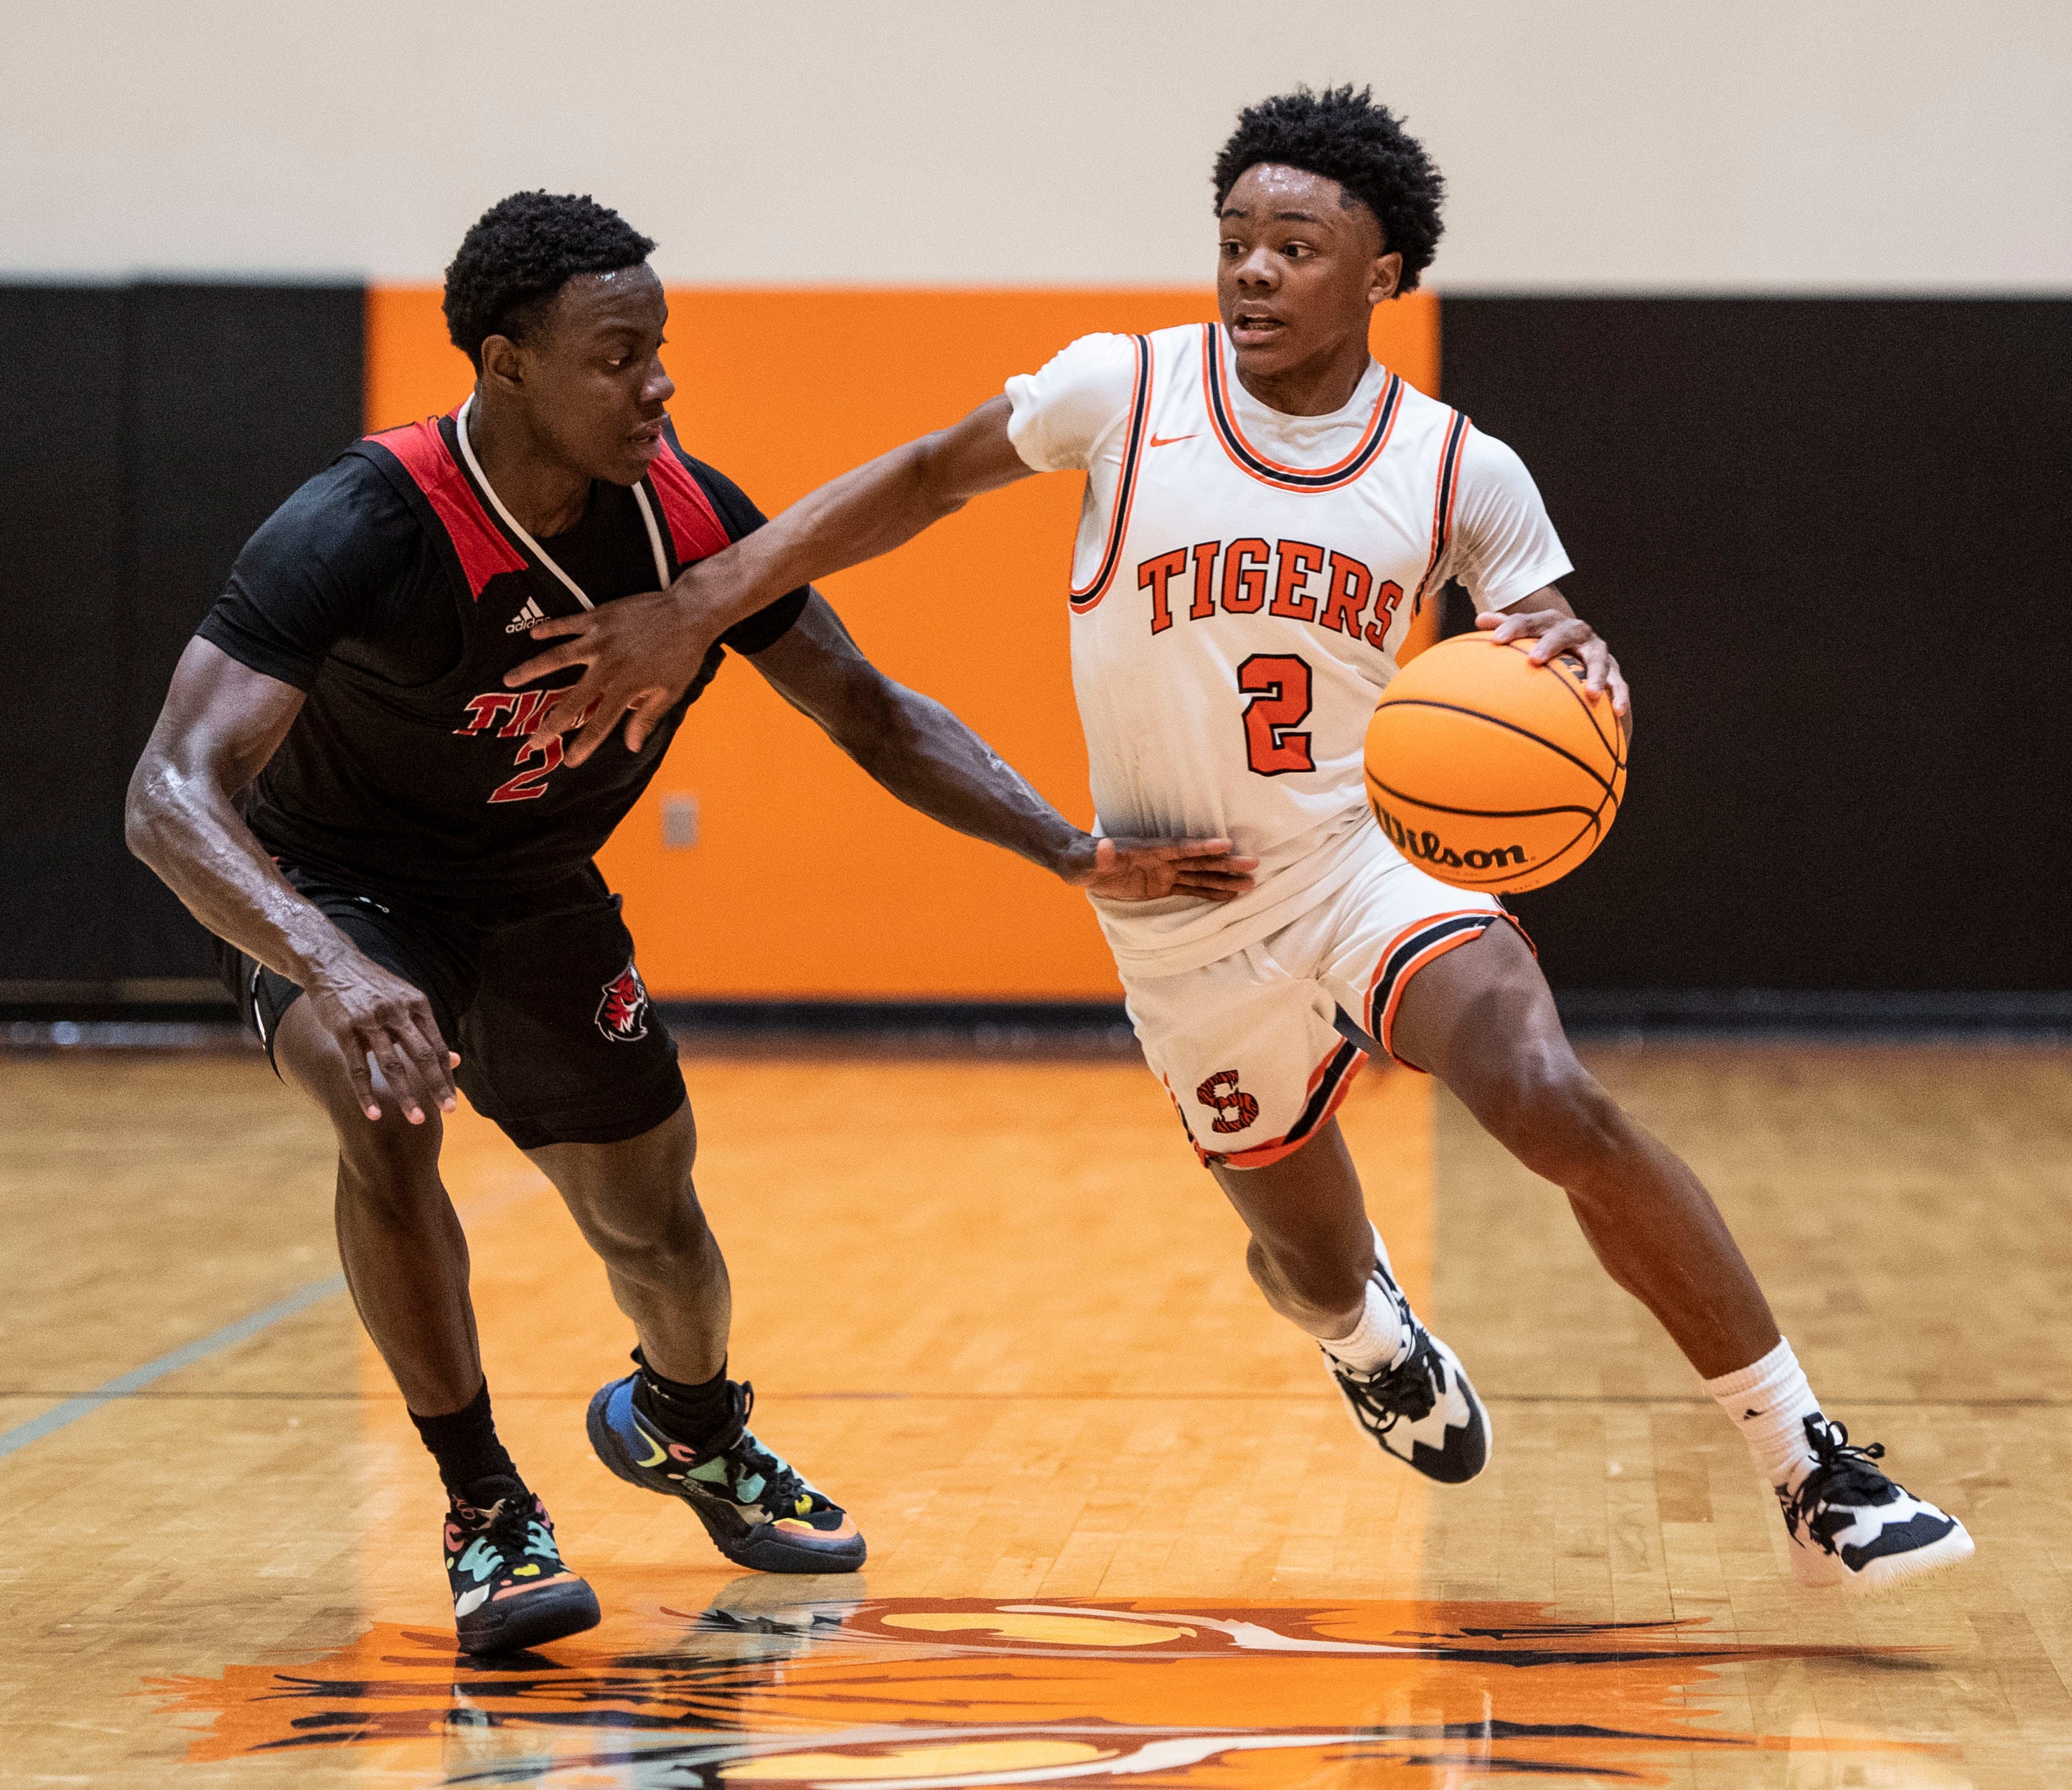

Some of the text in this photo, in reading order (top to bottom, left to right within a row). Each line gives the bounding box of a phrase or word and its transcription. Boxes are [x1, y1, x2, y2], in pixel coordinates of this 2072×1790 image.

[505, 617, 551, 633] adid
[1138, 538, 1404, 652] TIGERS
[1237, 653, 1316, 777] 2
[487, 734, 564, 803] 2
[1372, 797, 1529, 869] Wilson
[1196, 1069, 1259, 1133] S
